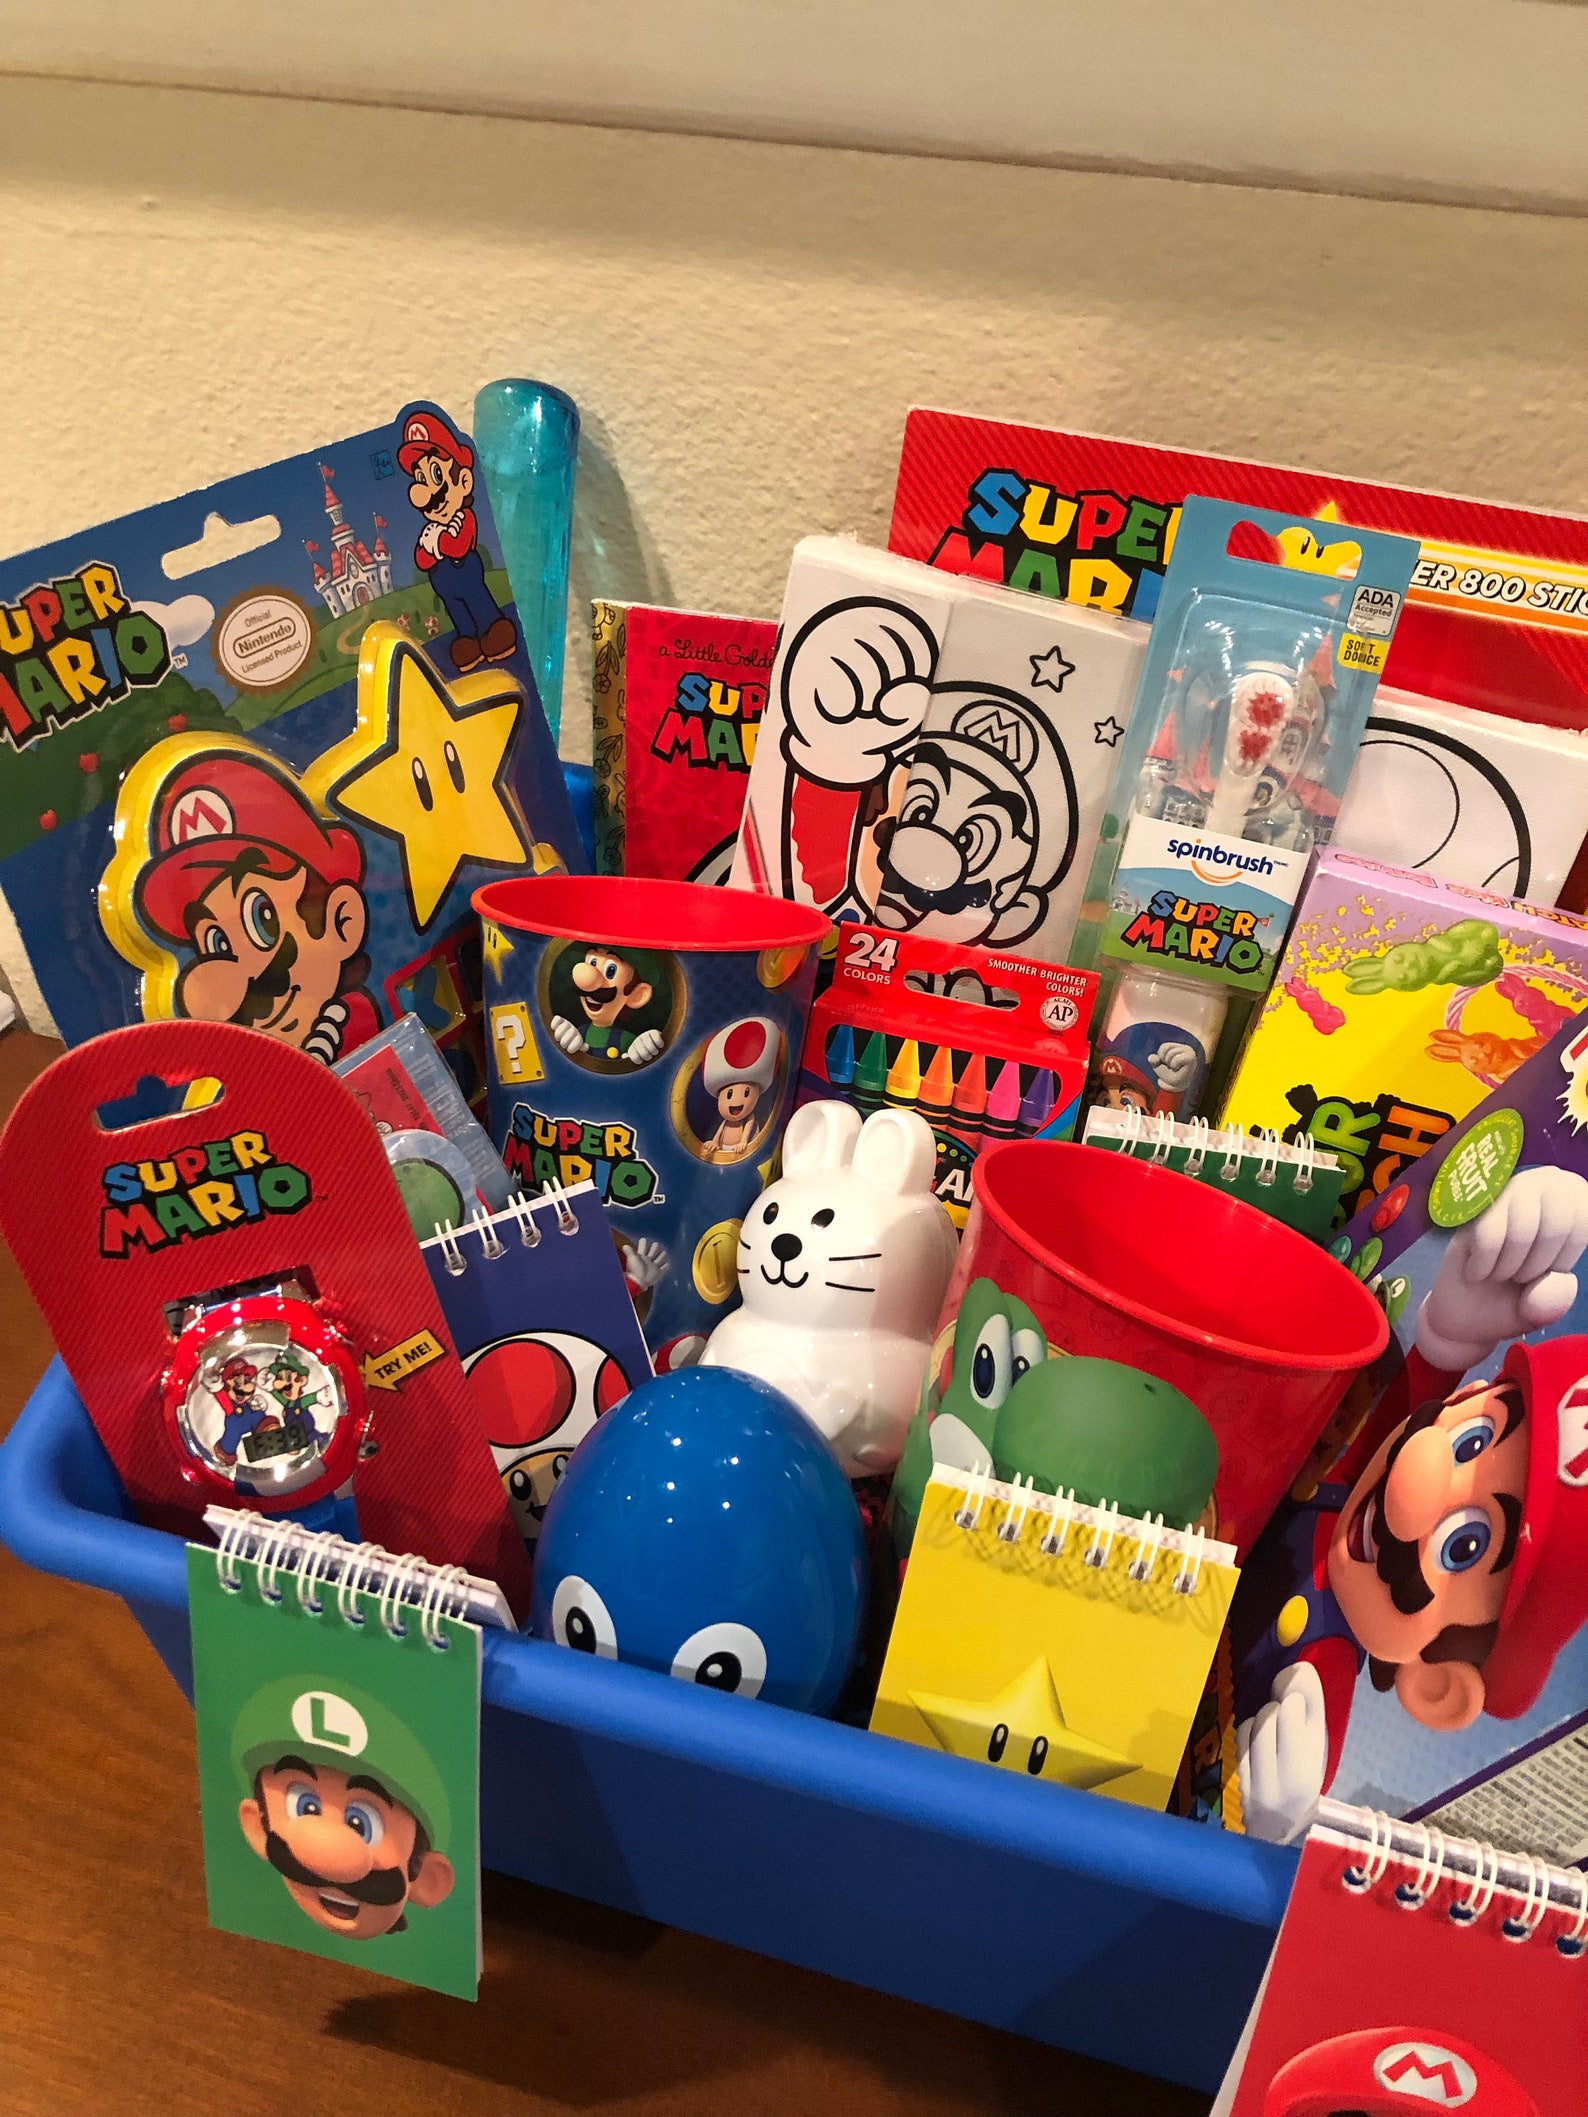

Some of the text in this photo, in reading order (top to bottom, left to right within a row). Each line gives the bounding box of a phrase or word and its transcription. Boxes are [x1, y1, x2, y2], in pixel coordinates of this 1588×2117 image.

[1358, 589, 1394, 608] ADA
[1459, 569, 1526, 603] 800
[244, 609, 271, 628] Official
[1355, 603, 1393, 617] Accepted
[238, 624, 292, 654] Nintendo
[241, 639, 302, 673] Licensed Product
[660, 646, 670, 656] a
[673, 638, 722, 663] Little
[1167, 838, 1274, 876] spinbrush
[1151, 891, 1257, 937] SUPER
[845, 932, 899, 972] 24
[1123, 914, 1263, 972] MARIO
[843, 967, 891, 985] COLORS
[988, 958, 1087, 987] SMOOTHER BRIGHTER
[1046, 981, 1084, 997] COLORS!
[1047, 1004, 1074, 1022] AP
[513, 1104, 631, 1157] SUPER
[105, 1131, 272, 1202] SUPER
[503, 1135, 652, 1199] MARIO
[1456, 1142, 1487, 1202] FRUIT
[1477, 1133, 1499, 1179] REAL
[103, 1165, 308, 1251] MARIO
[374, 1341, 432, 1379] TRY ME!
[310, 1697, 350, 1748] L
[1383, 2050, 1461, 2098] M
